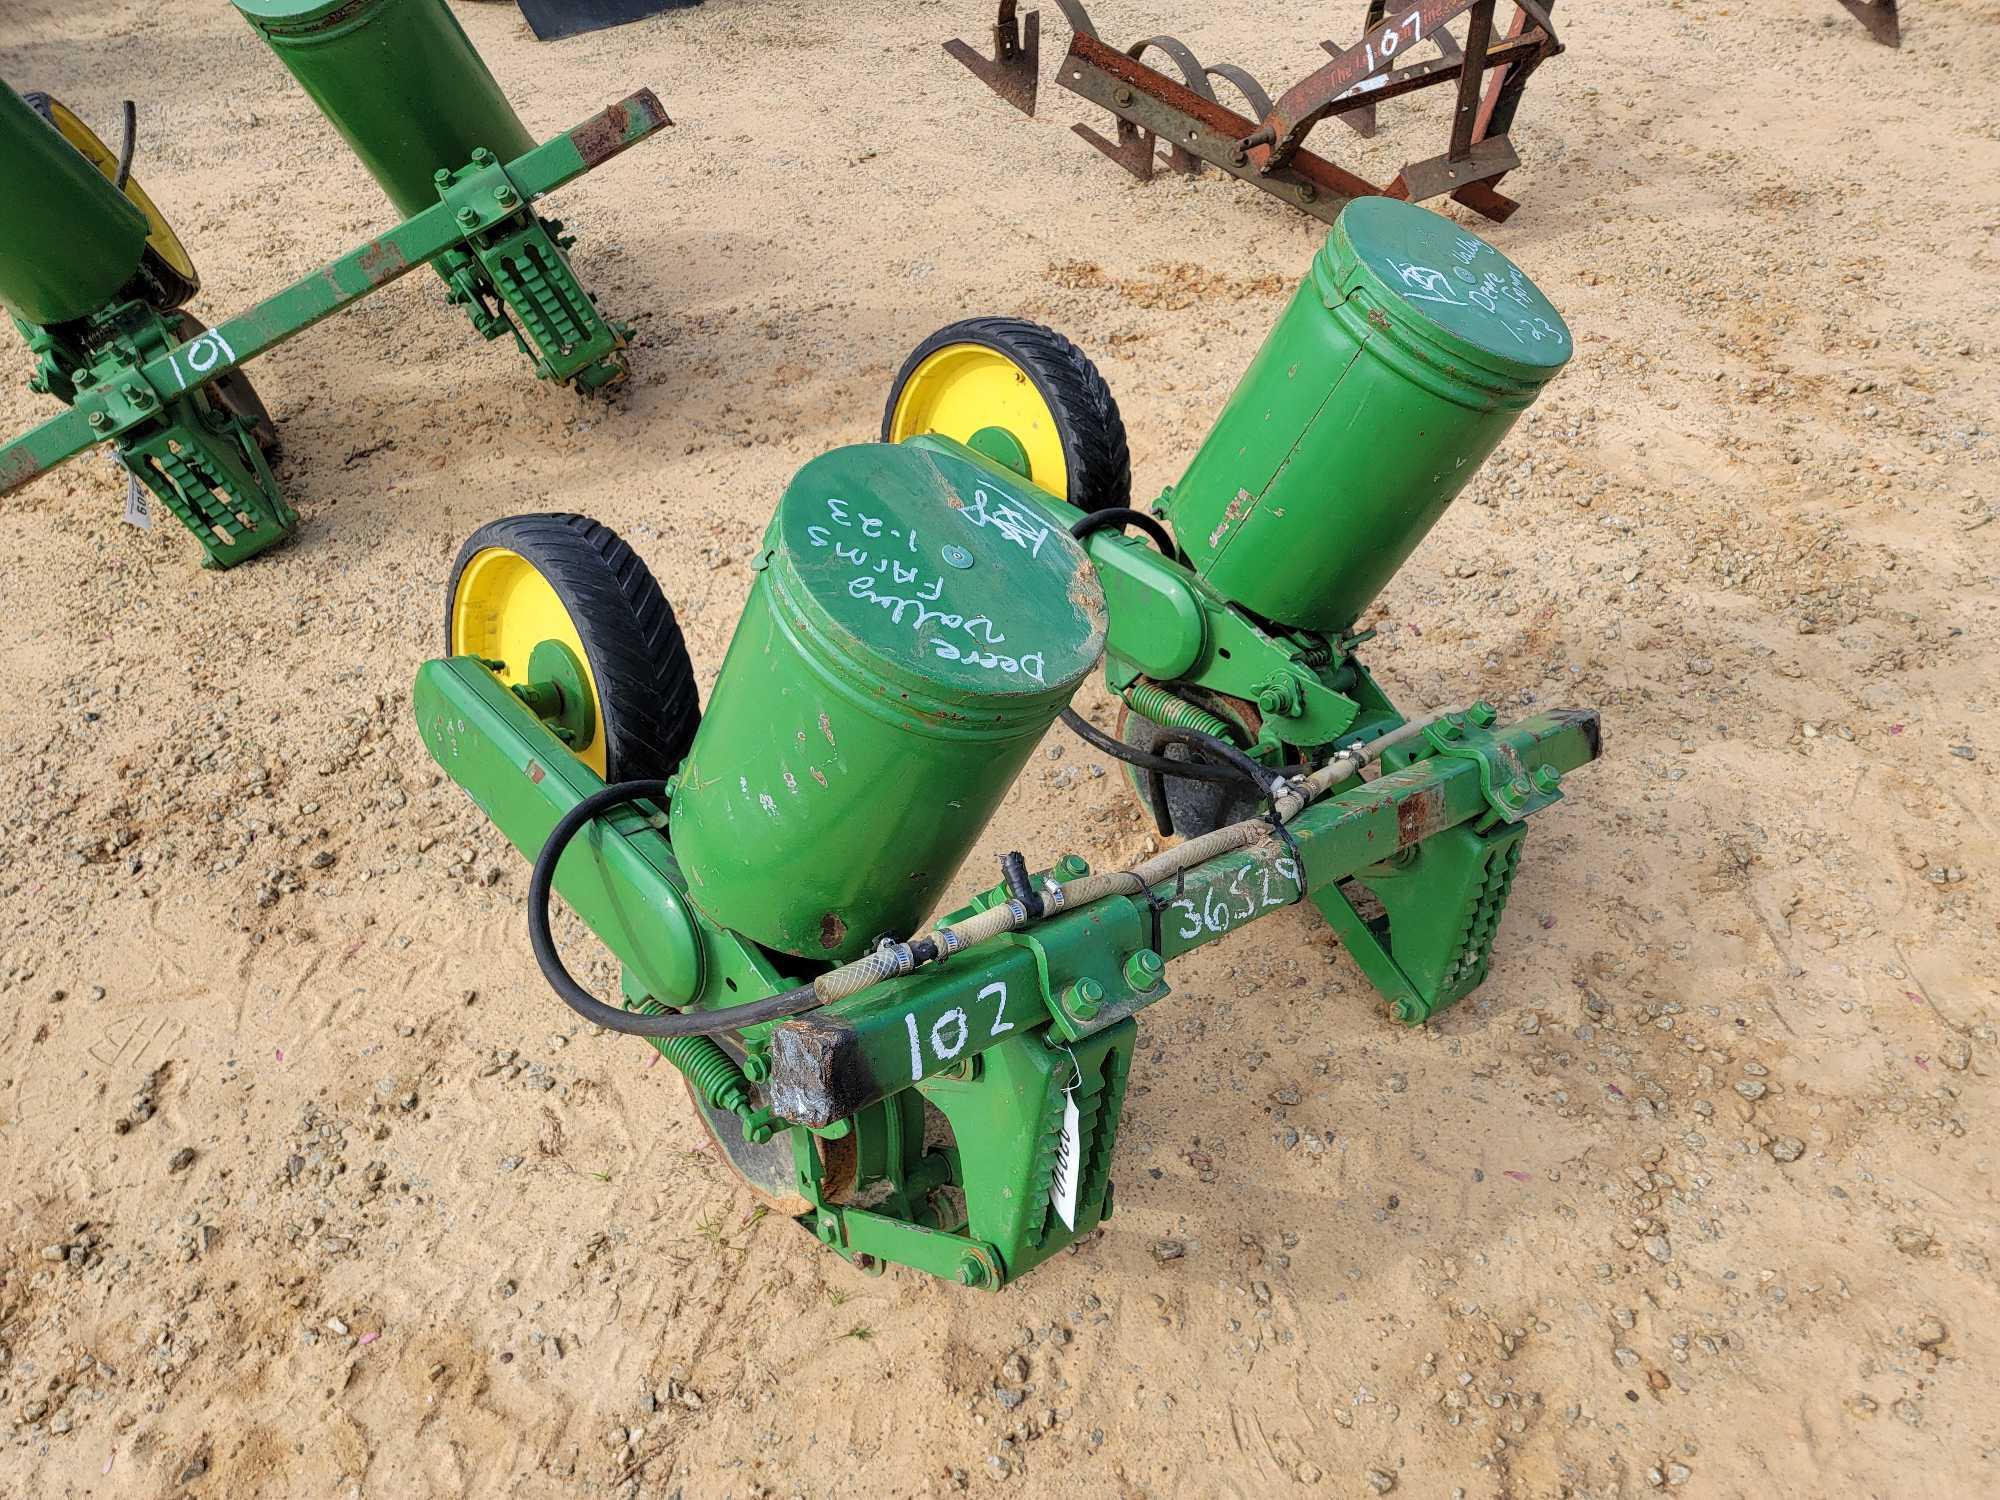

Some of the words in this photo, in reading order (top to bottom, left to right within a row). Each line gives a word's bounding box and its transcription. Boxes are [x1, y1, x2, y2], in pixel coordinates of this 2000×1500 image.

[1365, 11, 1420, 73] 107
[168, 328, 236, 390] 101
[828, 498, 918, 552] 1-23
[848, 576, 1006, 644] Valley
[931, 637, 1047, 686] Deere
[1171, 857, 1303, 940] 36529
[905, 981, 1015, 1081] 102
